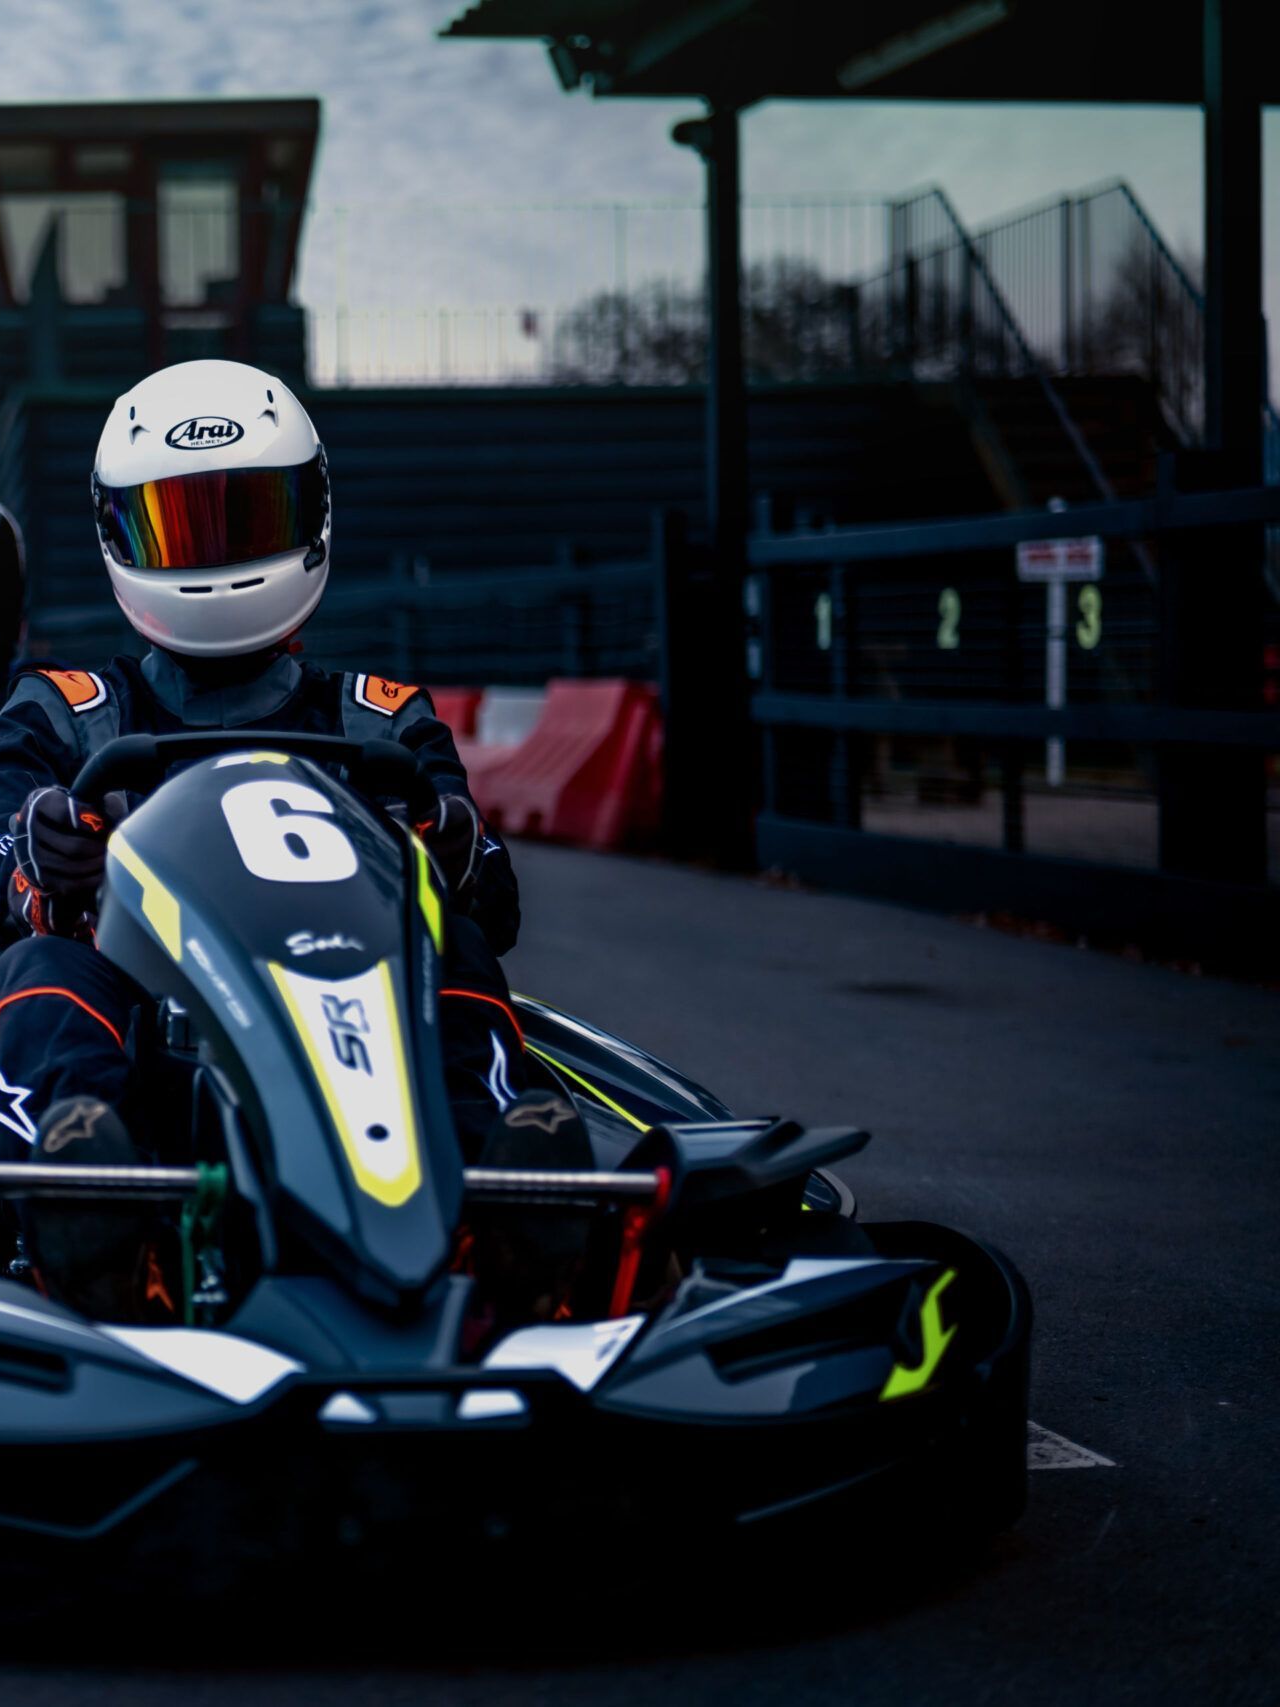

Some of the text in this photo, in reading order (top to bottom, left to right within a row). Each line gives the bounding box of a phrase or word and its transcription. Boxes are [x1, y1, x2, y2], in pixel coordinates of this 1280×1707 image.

[171, 420, 235, 444] Arai
[814, 592, 832, 650] 1
[936, 587, 961, 650] 2
[1076, 584, 1102, 650] 3
[221, 780, 359, 882] 6
